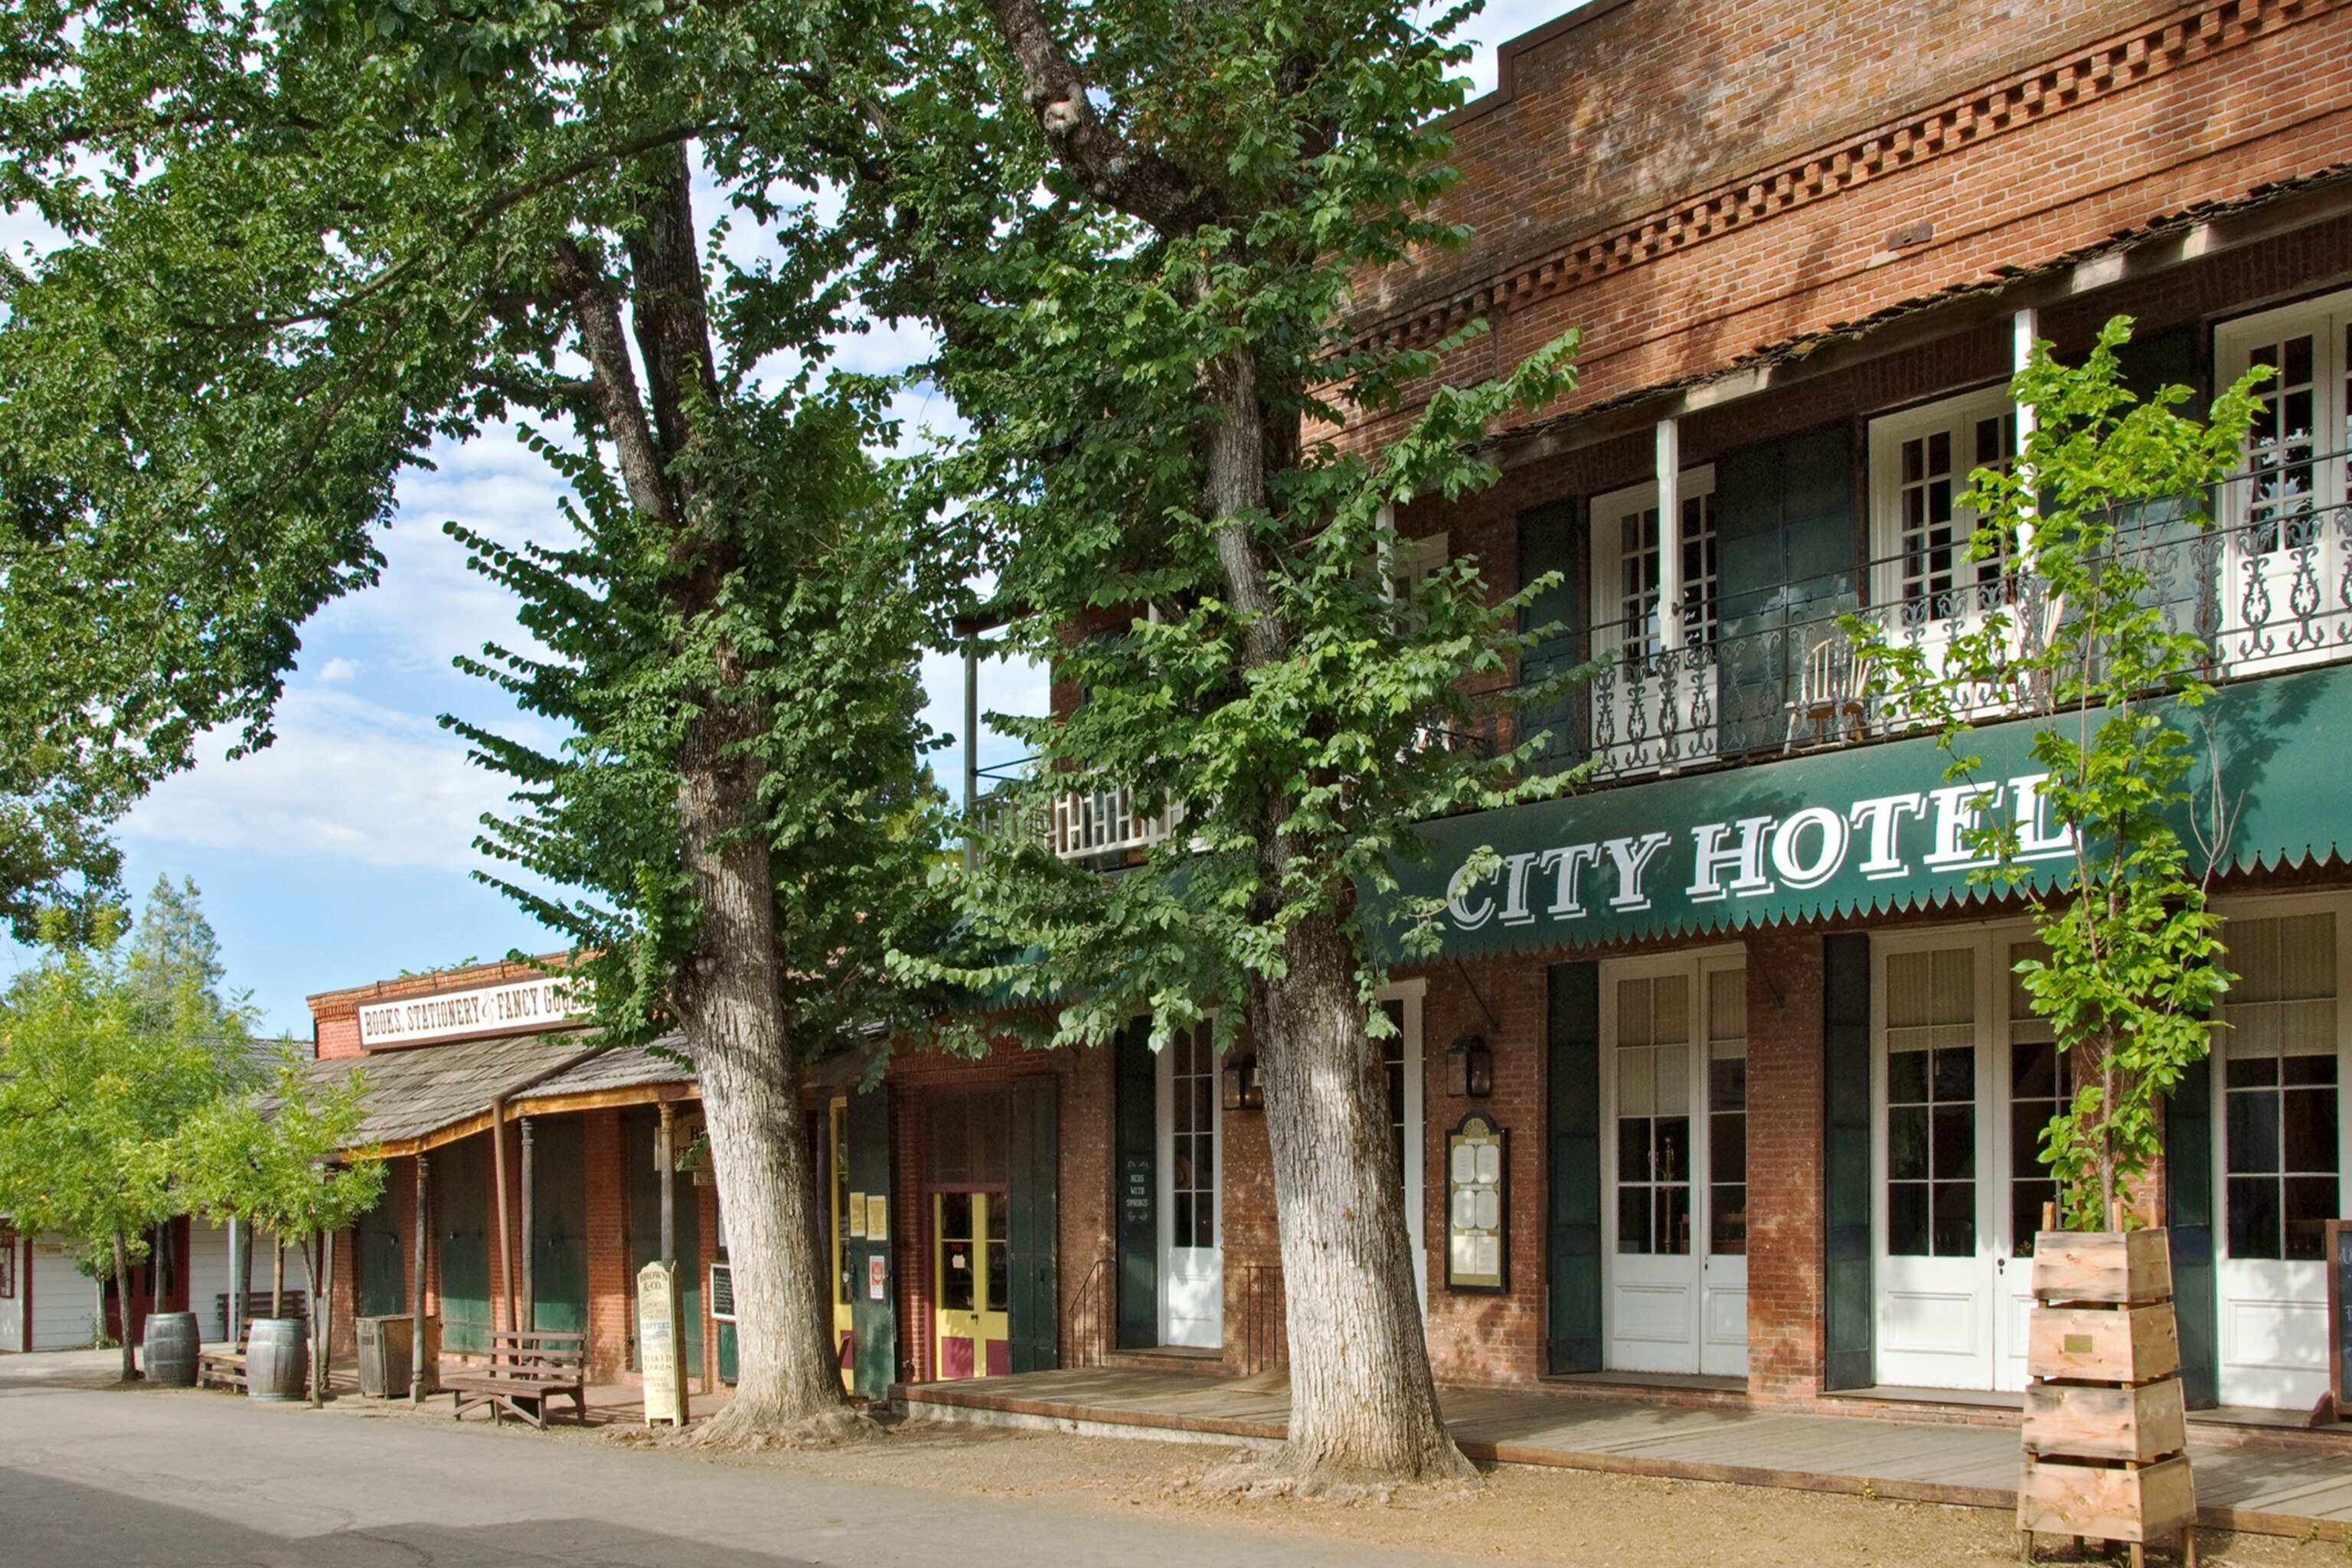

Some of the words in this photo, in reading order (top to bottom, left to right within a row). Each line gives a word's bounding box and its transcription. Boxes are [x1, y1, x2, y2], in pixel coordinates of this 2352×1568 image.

[1447, 831, 1671, 930] CITY
[1685, 772, 2082, 904] HOTEL
[364, 1007, 404, 1037] BOOKS,
[407, 996, 480, 1032] STATIONERY
[496, 986, 538, 1021] FANCY
[639, 1271, 668, 1283] BROWN
[644, 1354, 672, 1363] BAKED
